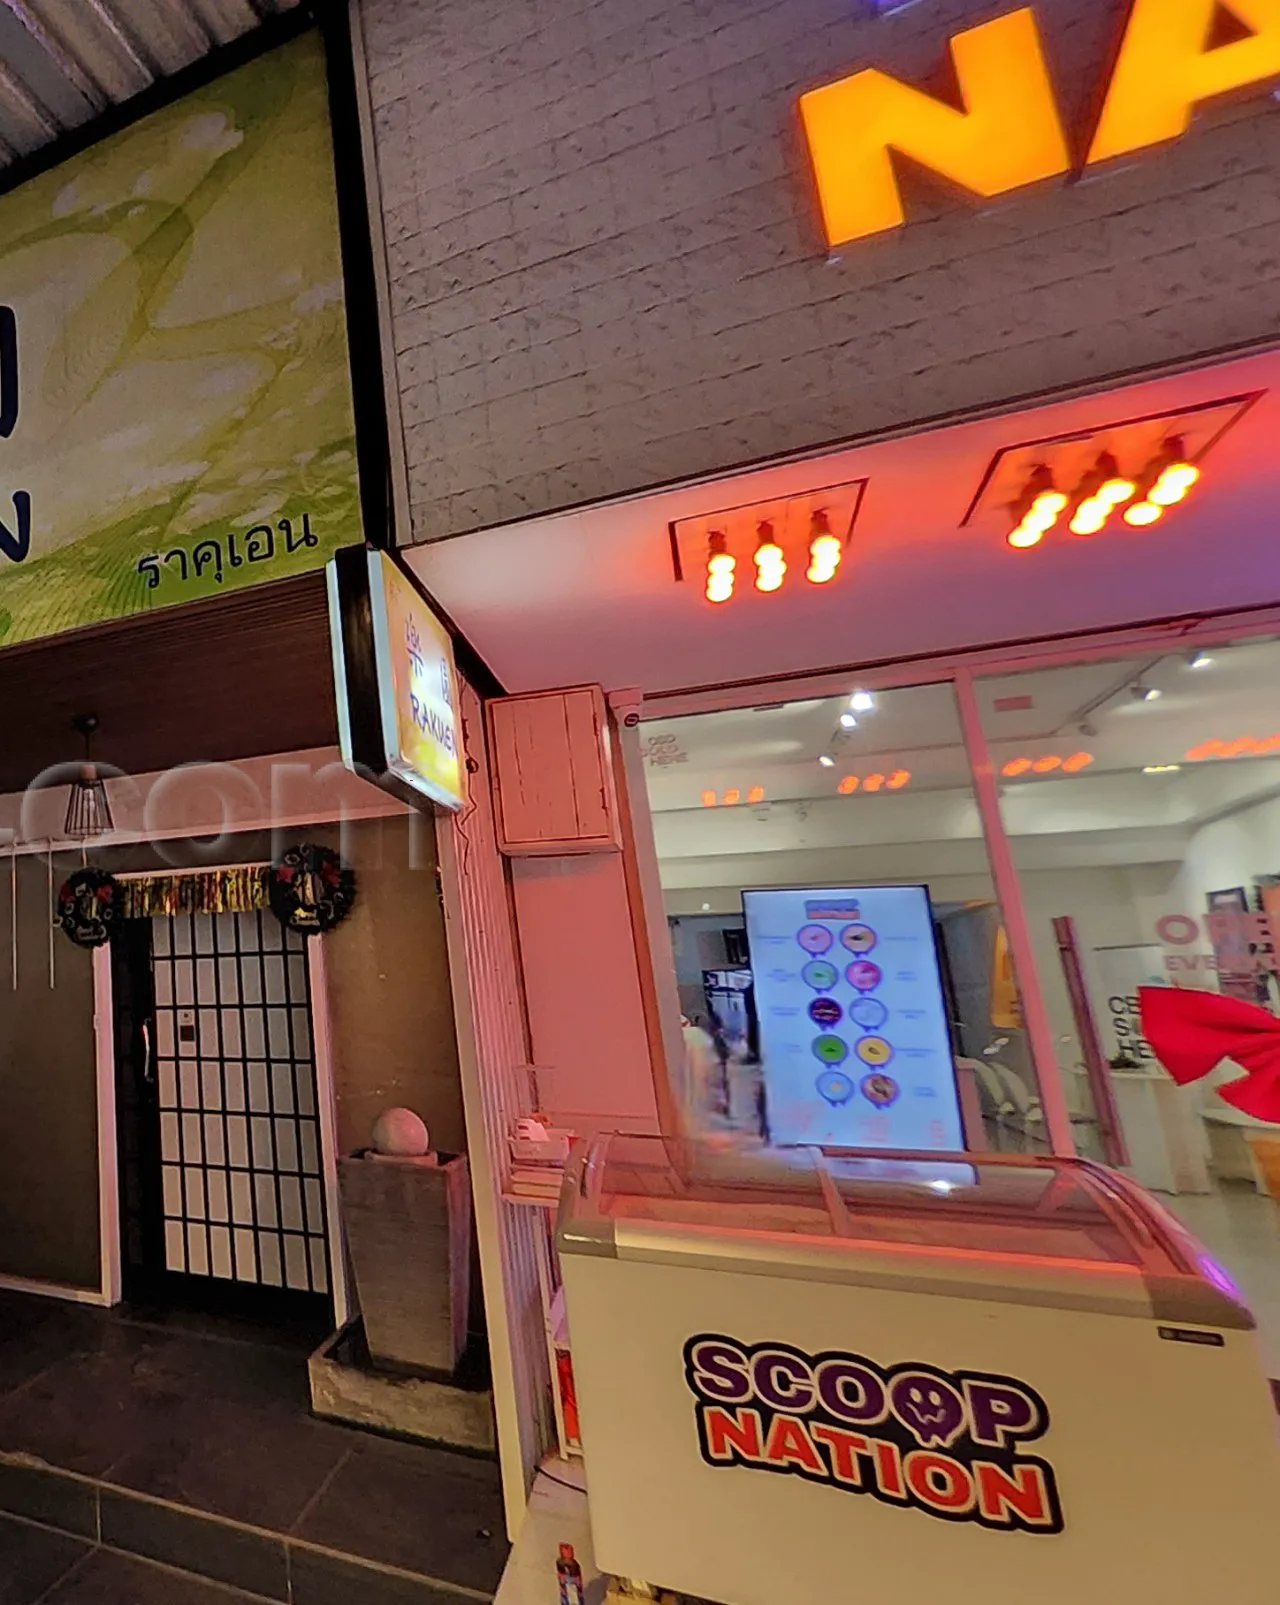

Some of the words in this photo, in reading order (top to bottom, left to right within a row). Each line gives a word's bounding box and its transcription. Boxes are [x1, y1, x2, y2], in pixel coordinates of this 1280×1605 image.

[138, 513, 319, 588] ราคุเอน
[692, 1340, 1036, 1447] SCOOP
[703, 1405, 1052, 1526] NATION
